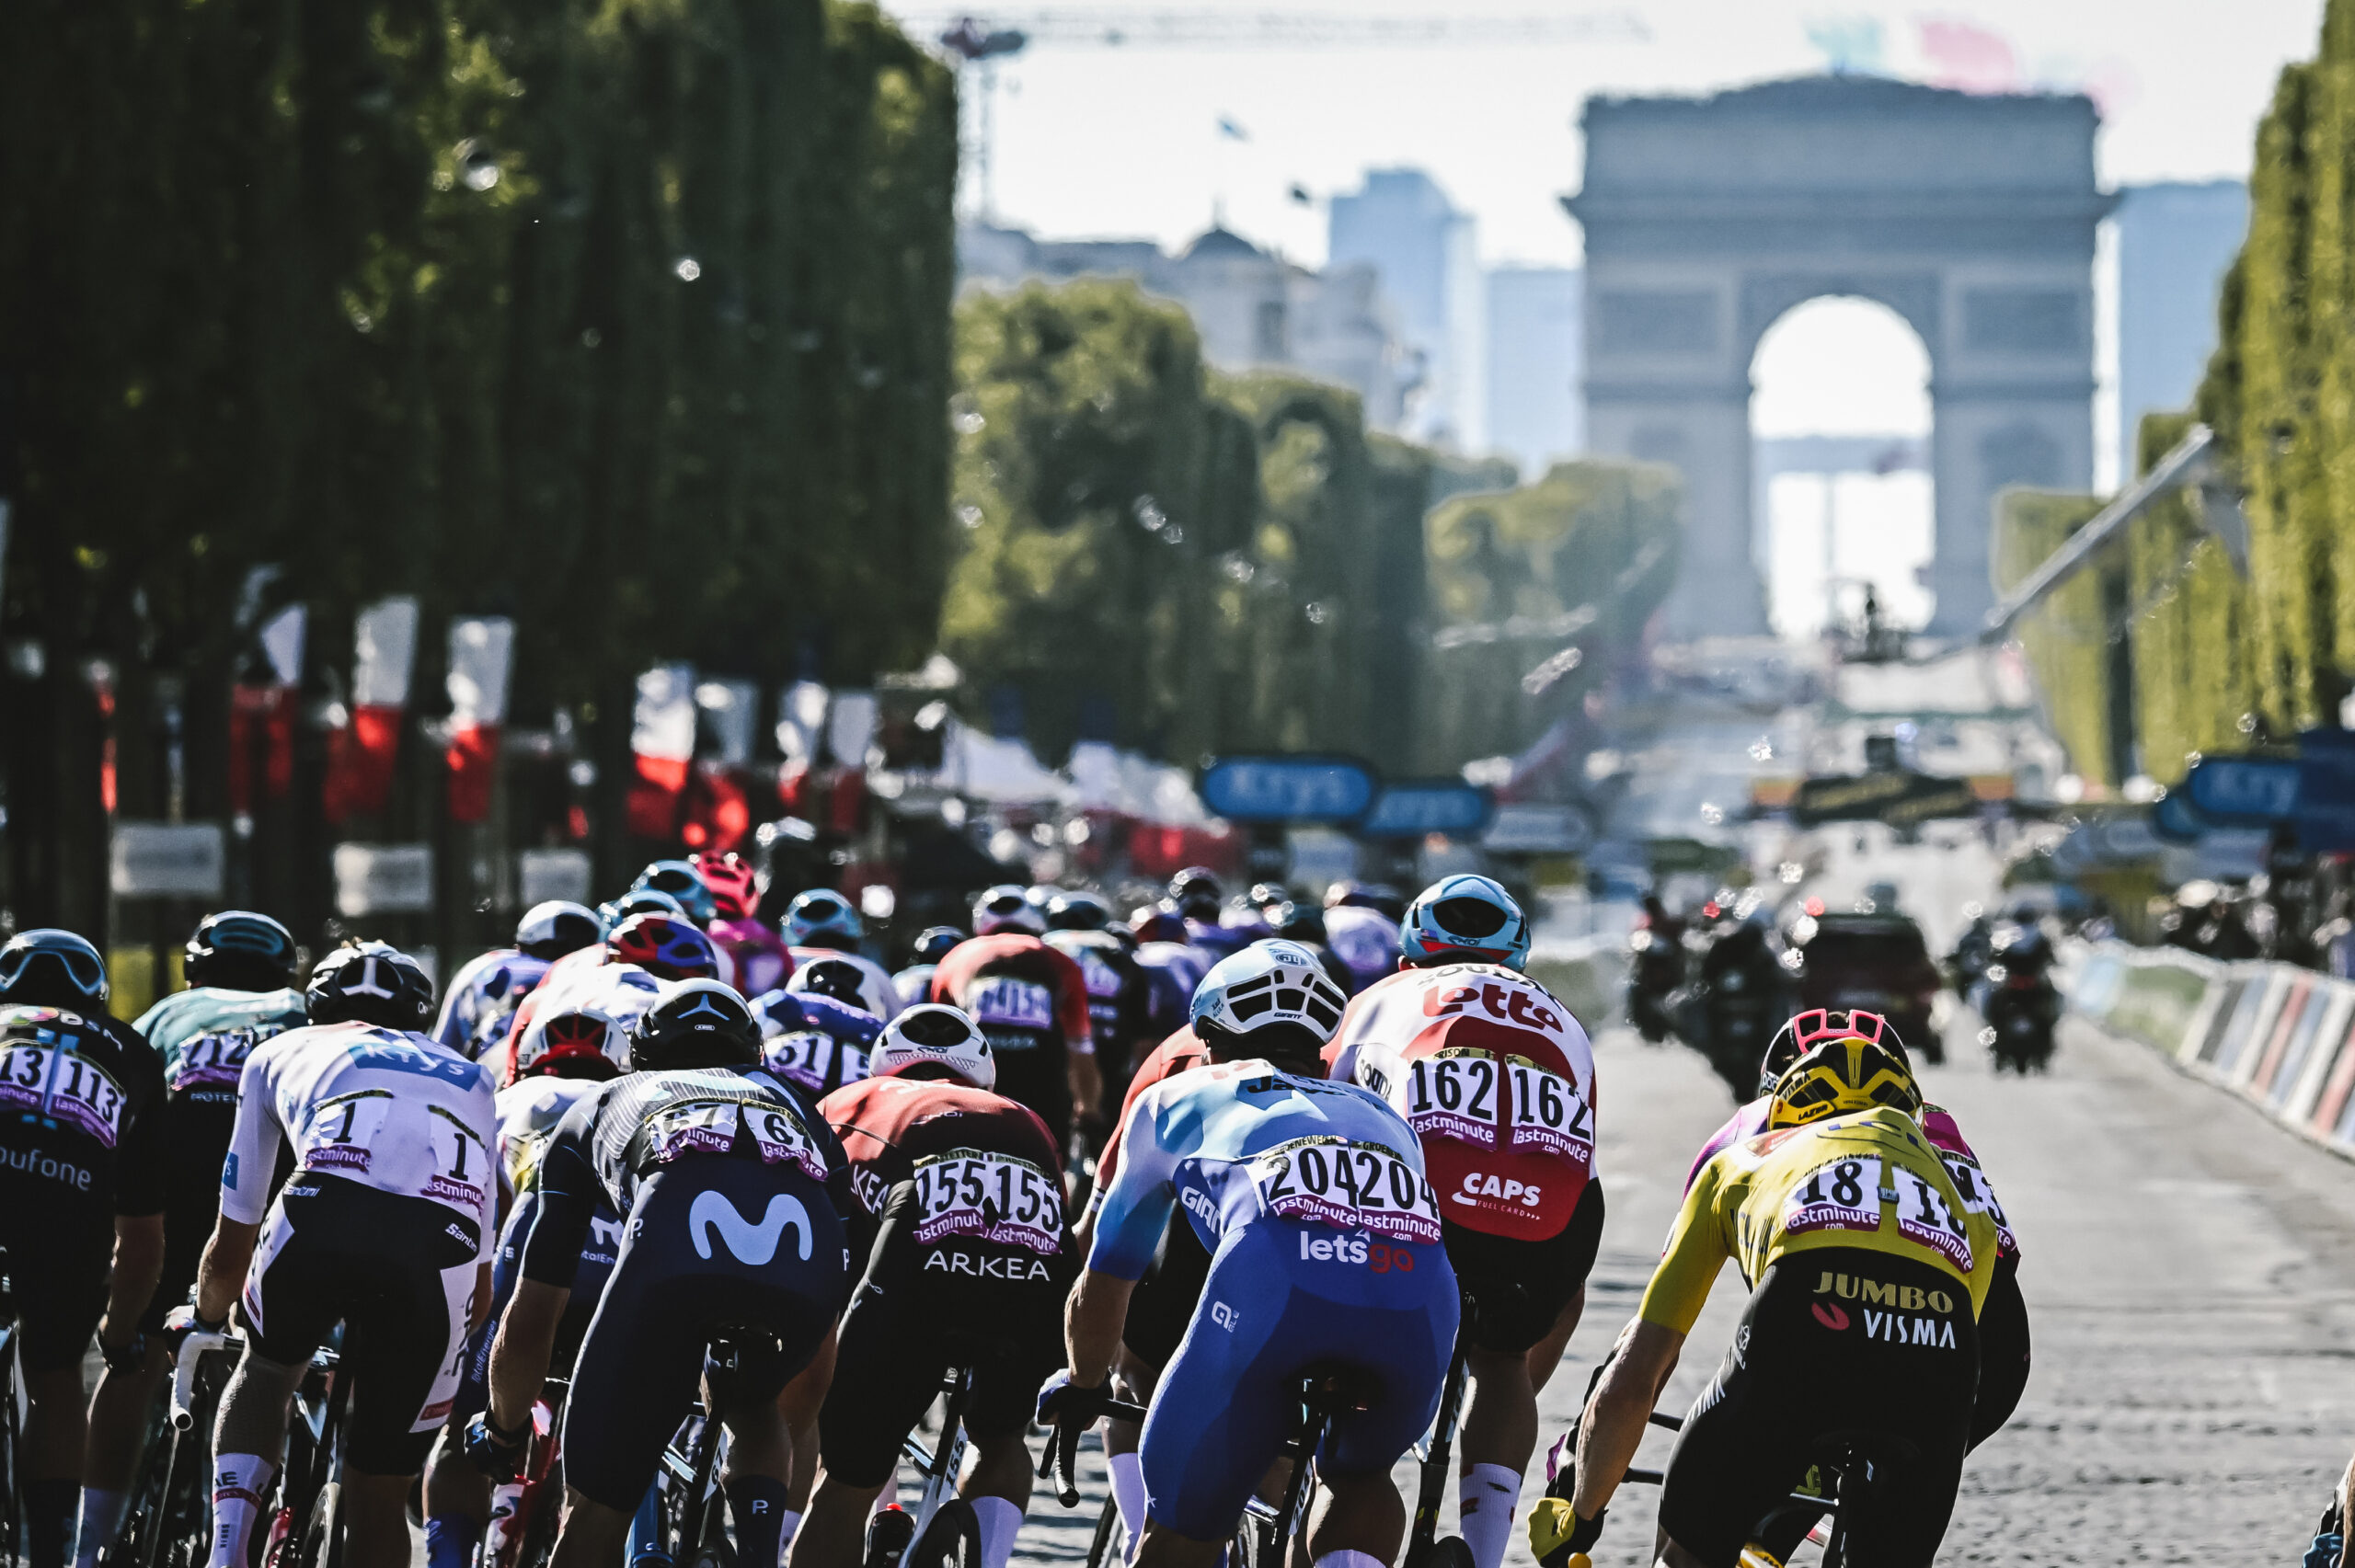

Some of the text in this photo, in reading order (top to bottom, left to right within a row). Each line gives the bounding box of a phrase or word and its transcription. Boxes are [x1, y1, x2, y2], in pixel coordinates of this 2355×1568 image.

[63, 1060, 119, 1124] 113
[1411, 1059, 1494, 1121] 162
[1514, 1069, 1591, 1141] 162
[332, 1102, 357, 1143] 1
[1798, 1104, 1829, 1121] LAZER
[448, 1132, 469, 1182] 1
[1513, 1128, 1589, 1162] lastminute
[919, 1161, 987, 1220] 155
[995, 1165, 1061, 1233] 155
[1267, 1148, 1359, 1210] 204
[1356, 1151, 1441, 1220] 204
[1463, 1173, 1542, 1207] CAPS
[1802, 1161, 1864, 1208] 18
[1273, 1196, 1357, 1227] lastminute
[1358, 1210, 1442, 1242] lastminute
[1476, 1200, 1525, 1218] FUEL CARD
[1786, 1205, 1881, 1230] lastminute
[1392, 1232, 1413, 1242] .com
[924, 1250, 1051, 1281] ARKEA
[1812, 1271, 1954, 1314] JUMBO
[1863, 1308, 1957, 1350] VISMA
[752, 1499, 769, 1515] P.
